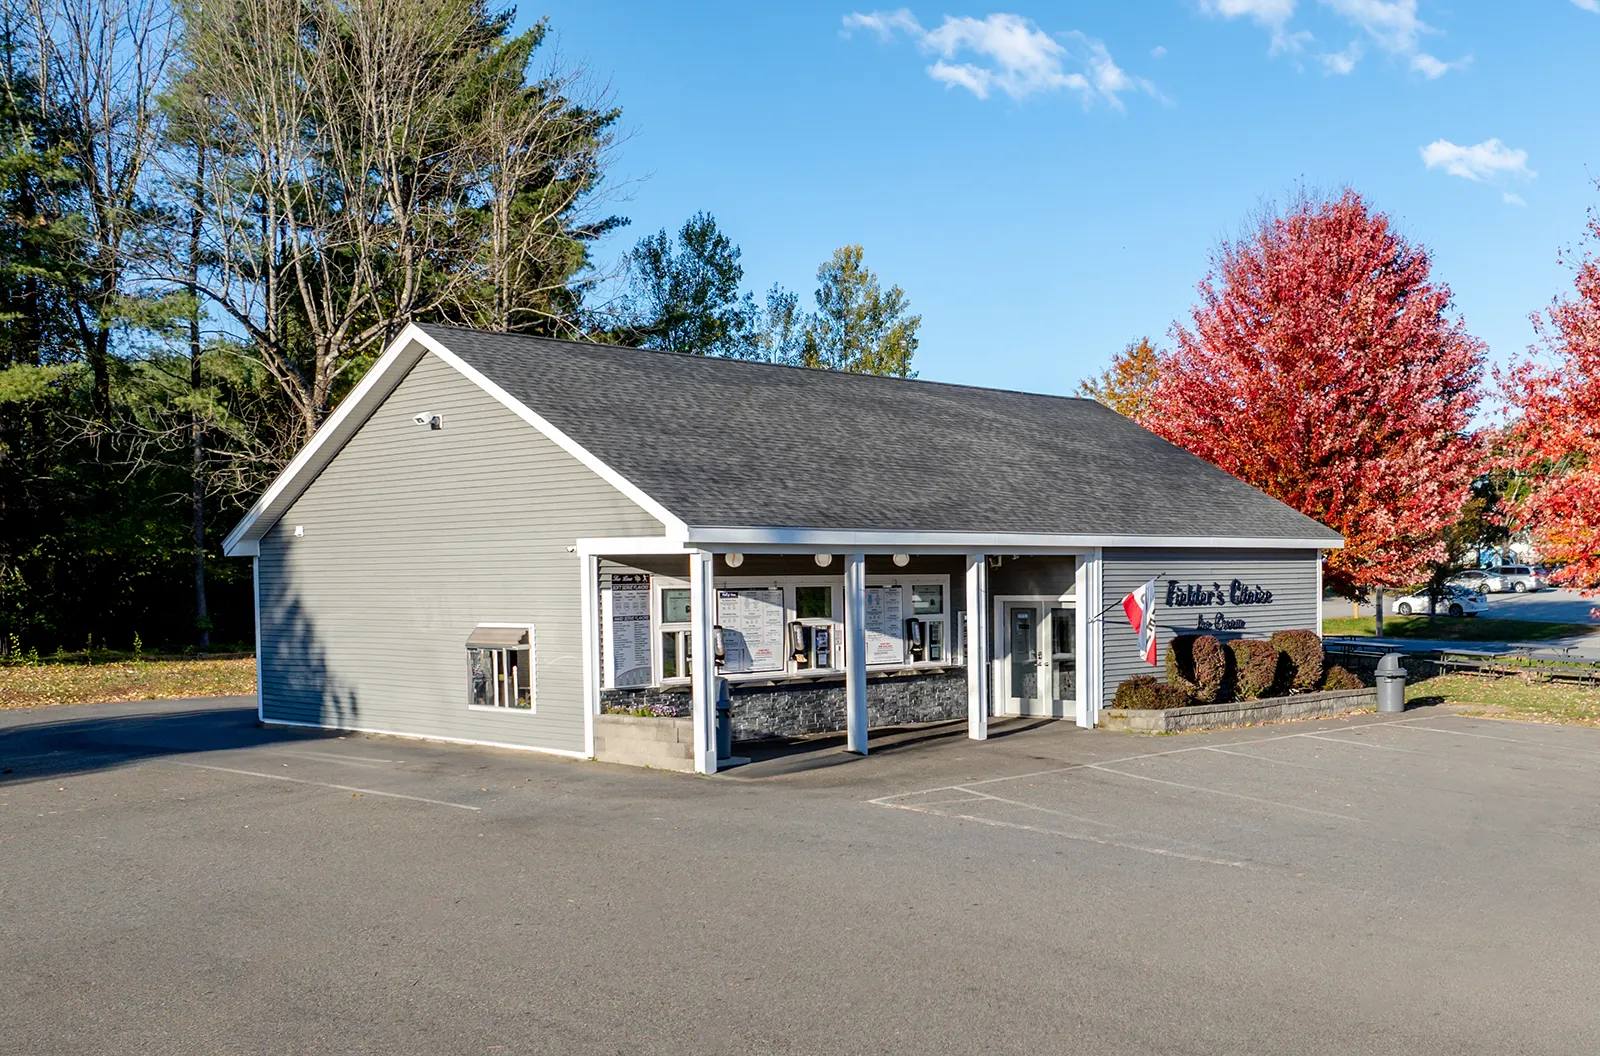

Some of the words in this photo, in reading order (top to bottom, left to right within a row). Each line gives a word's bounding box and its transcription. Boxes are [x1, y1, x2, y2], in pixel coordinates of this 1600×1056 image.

[1166, 580, 1226, 608] Fielder's
[1229, 578, 1274, 606] Choice
[1197, 613, 1213, 630] Ice
[1214, 612, 1247, 630] Cream
